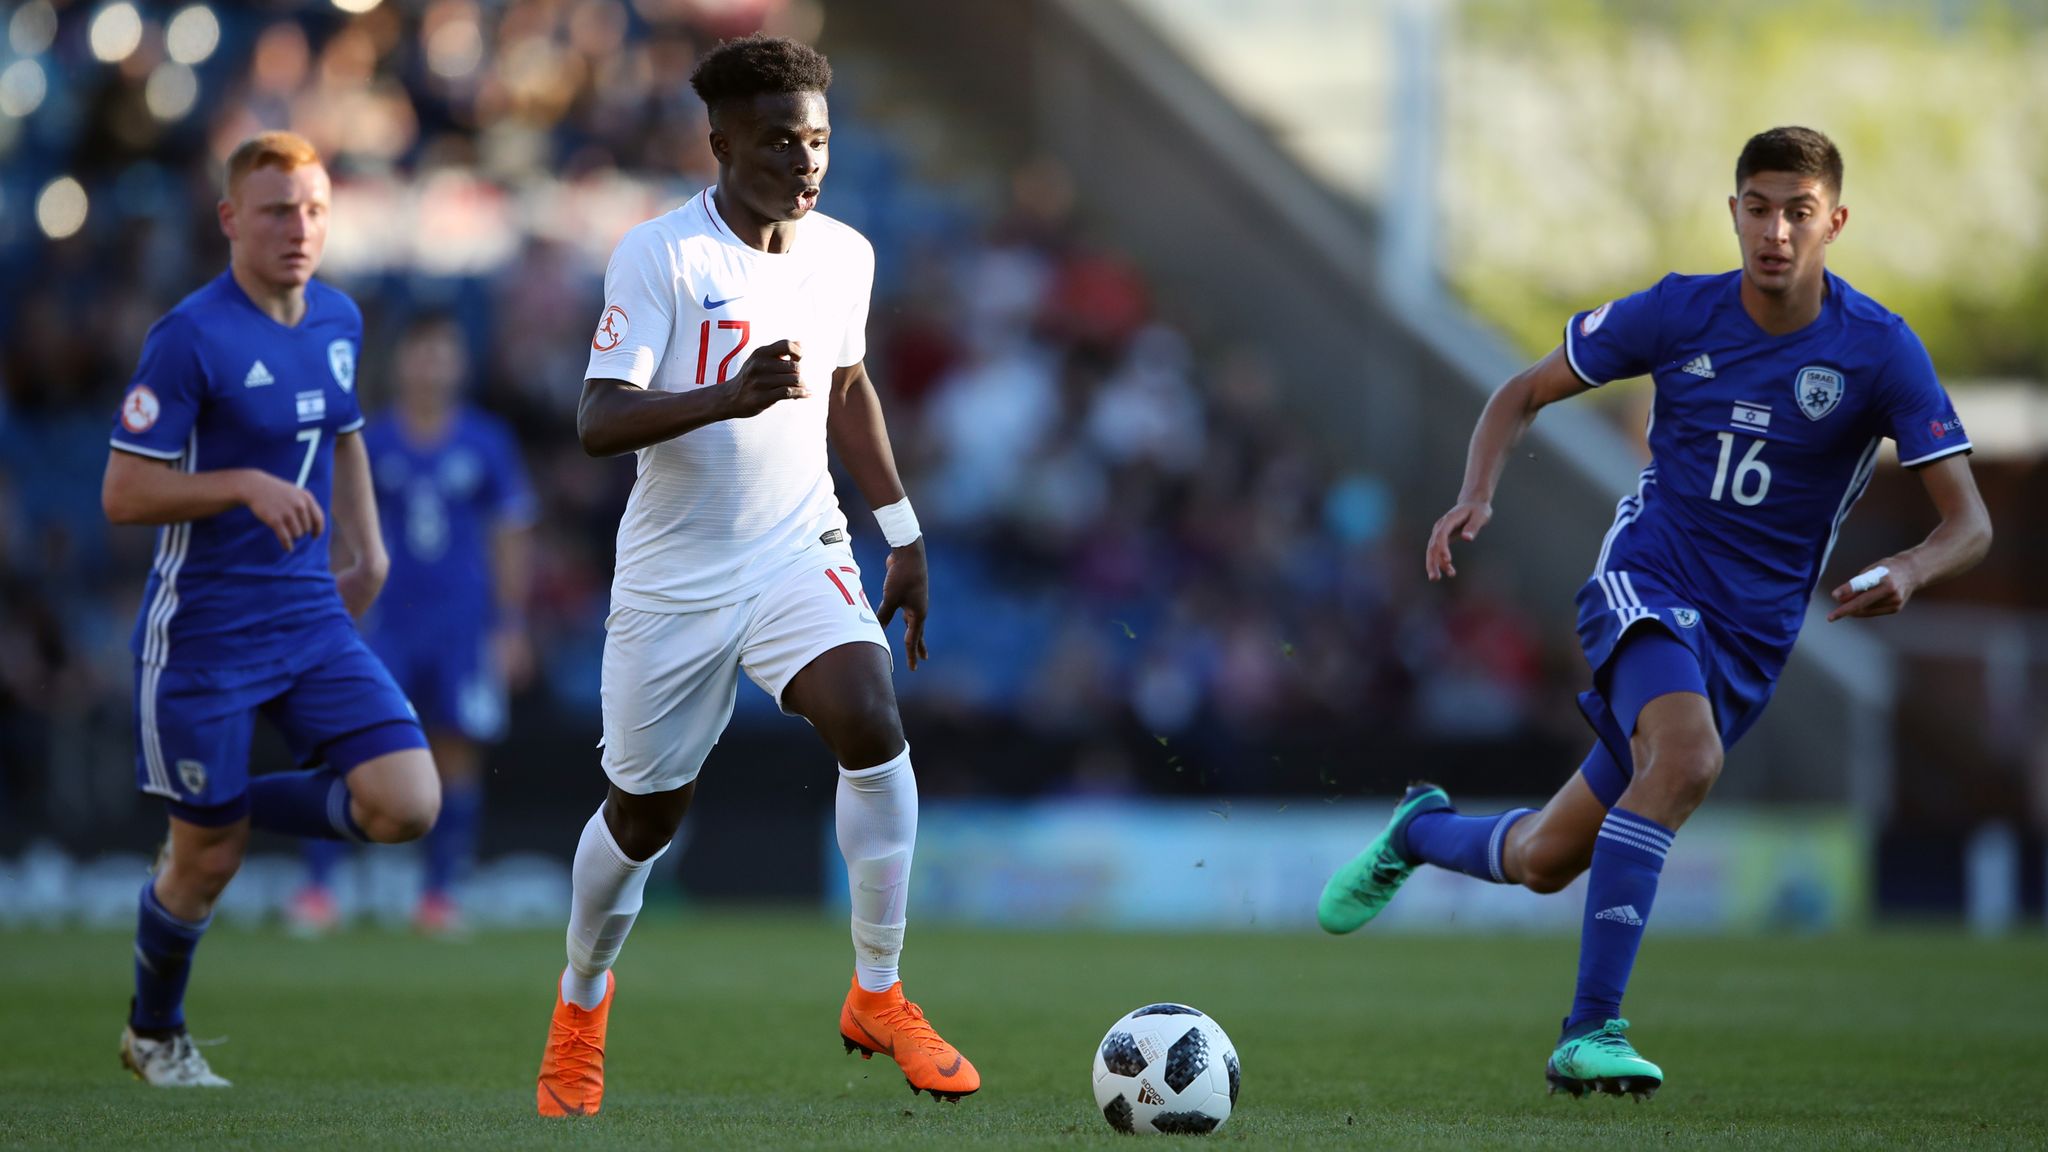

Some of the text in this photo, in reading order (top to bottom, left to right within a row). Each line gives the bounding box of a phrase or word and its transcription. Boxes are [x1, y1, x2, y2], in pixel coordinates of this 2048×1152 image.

[696, 320, 750, 385] 17
[1681, 365, 1716, 378] adidas
[1807, 371, 1835, 383] ISRAEL
[296, 428, 321, 489] 7
[1709, 431, 1772, 507] 16
[1595, 910, 1643, 926] adidas
[1138, 1039, 1155, 1063] TELSTRA
[1141, 1078, 1165, 1105] adidas
